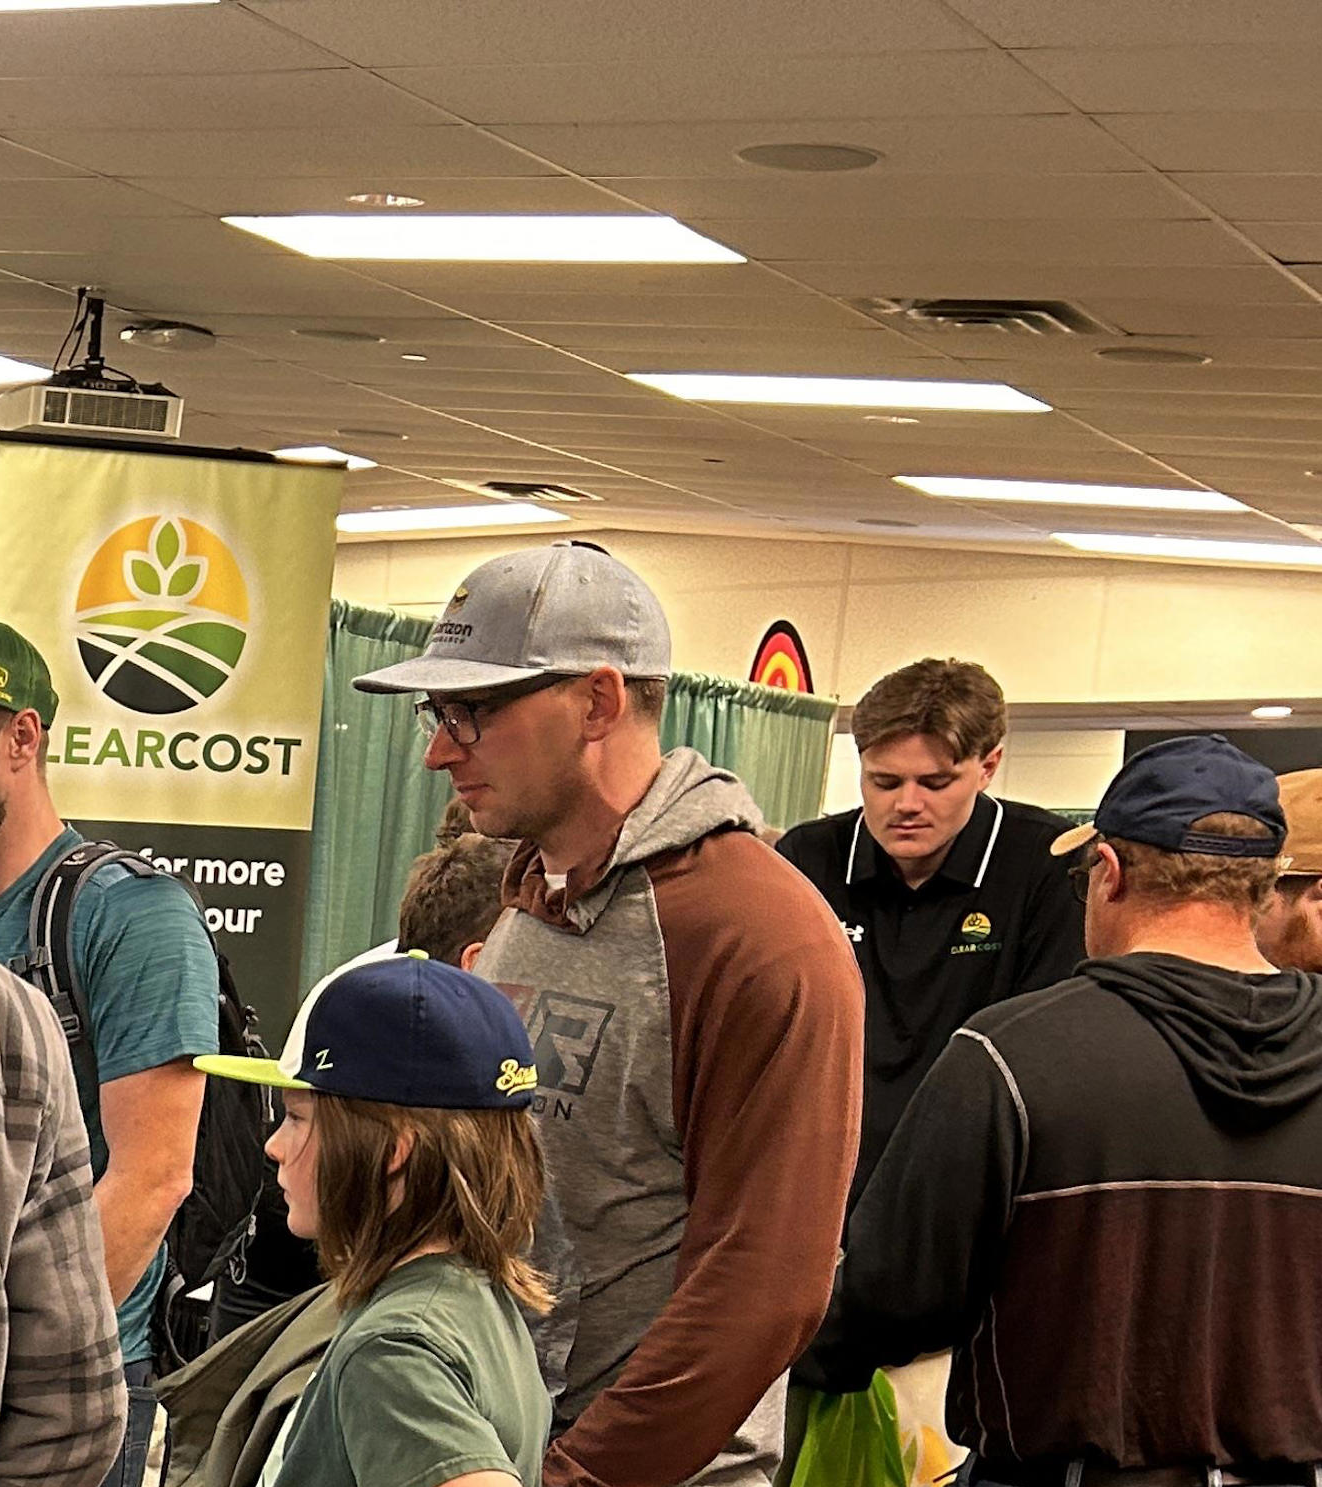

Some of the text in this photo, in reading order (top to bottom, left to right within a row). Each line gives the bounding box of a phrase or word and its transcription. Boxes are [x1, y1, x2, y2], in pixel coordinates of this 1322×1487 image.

[433, 620, 473, 637] orizon
[47, 725, 302, 776] EARCOST
[194, 859, 285, 887] more
[204, 907, 262, 933] our
